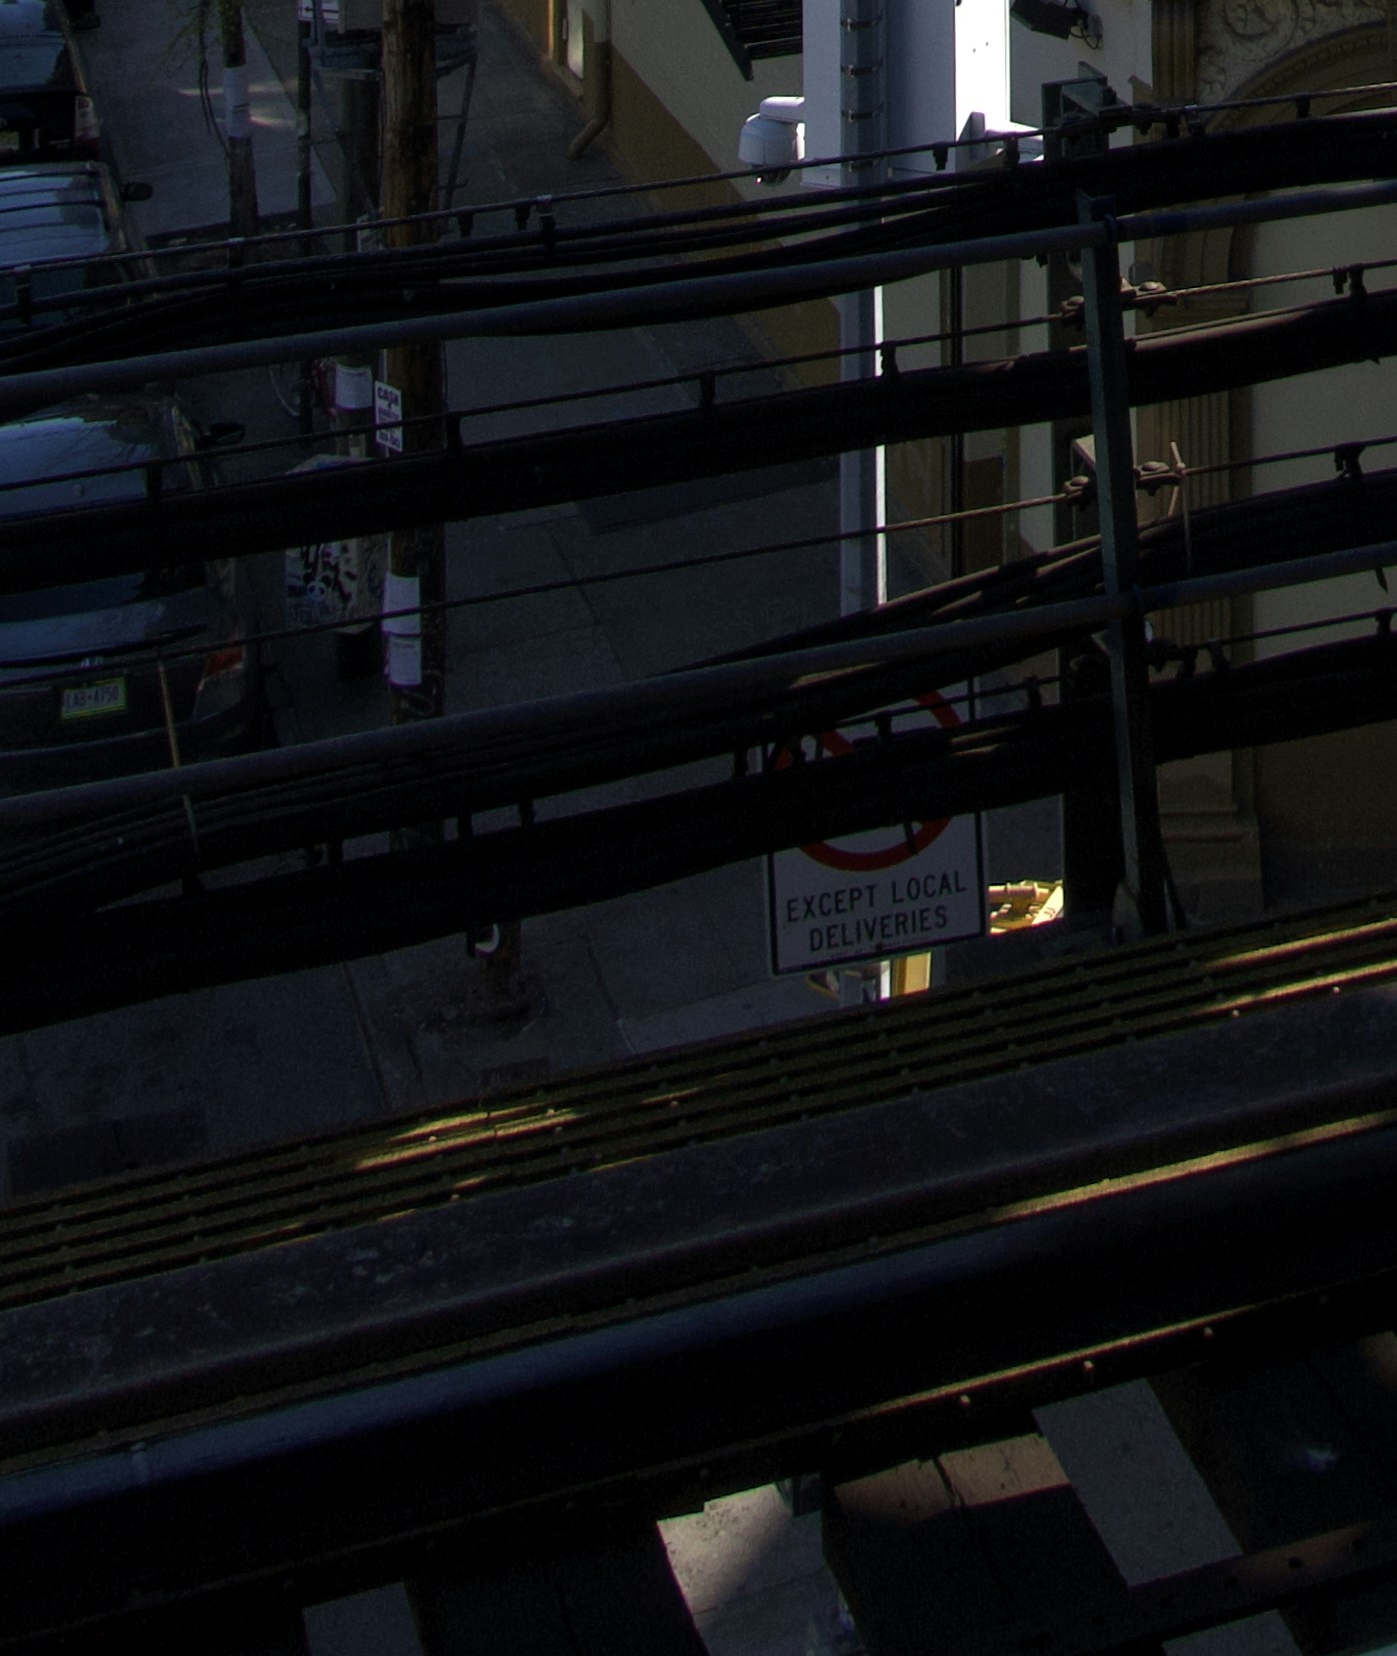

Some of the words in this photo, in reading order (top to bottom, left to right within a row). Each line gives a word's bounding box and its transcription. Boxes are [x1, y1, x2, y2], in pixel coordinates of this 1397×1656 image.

[787, 885, 877, 922] EXCEPT
[892, 871, 966, 903] LOCAL
[810, 906, 948, 951] DELIVERIES
